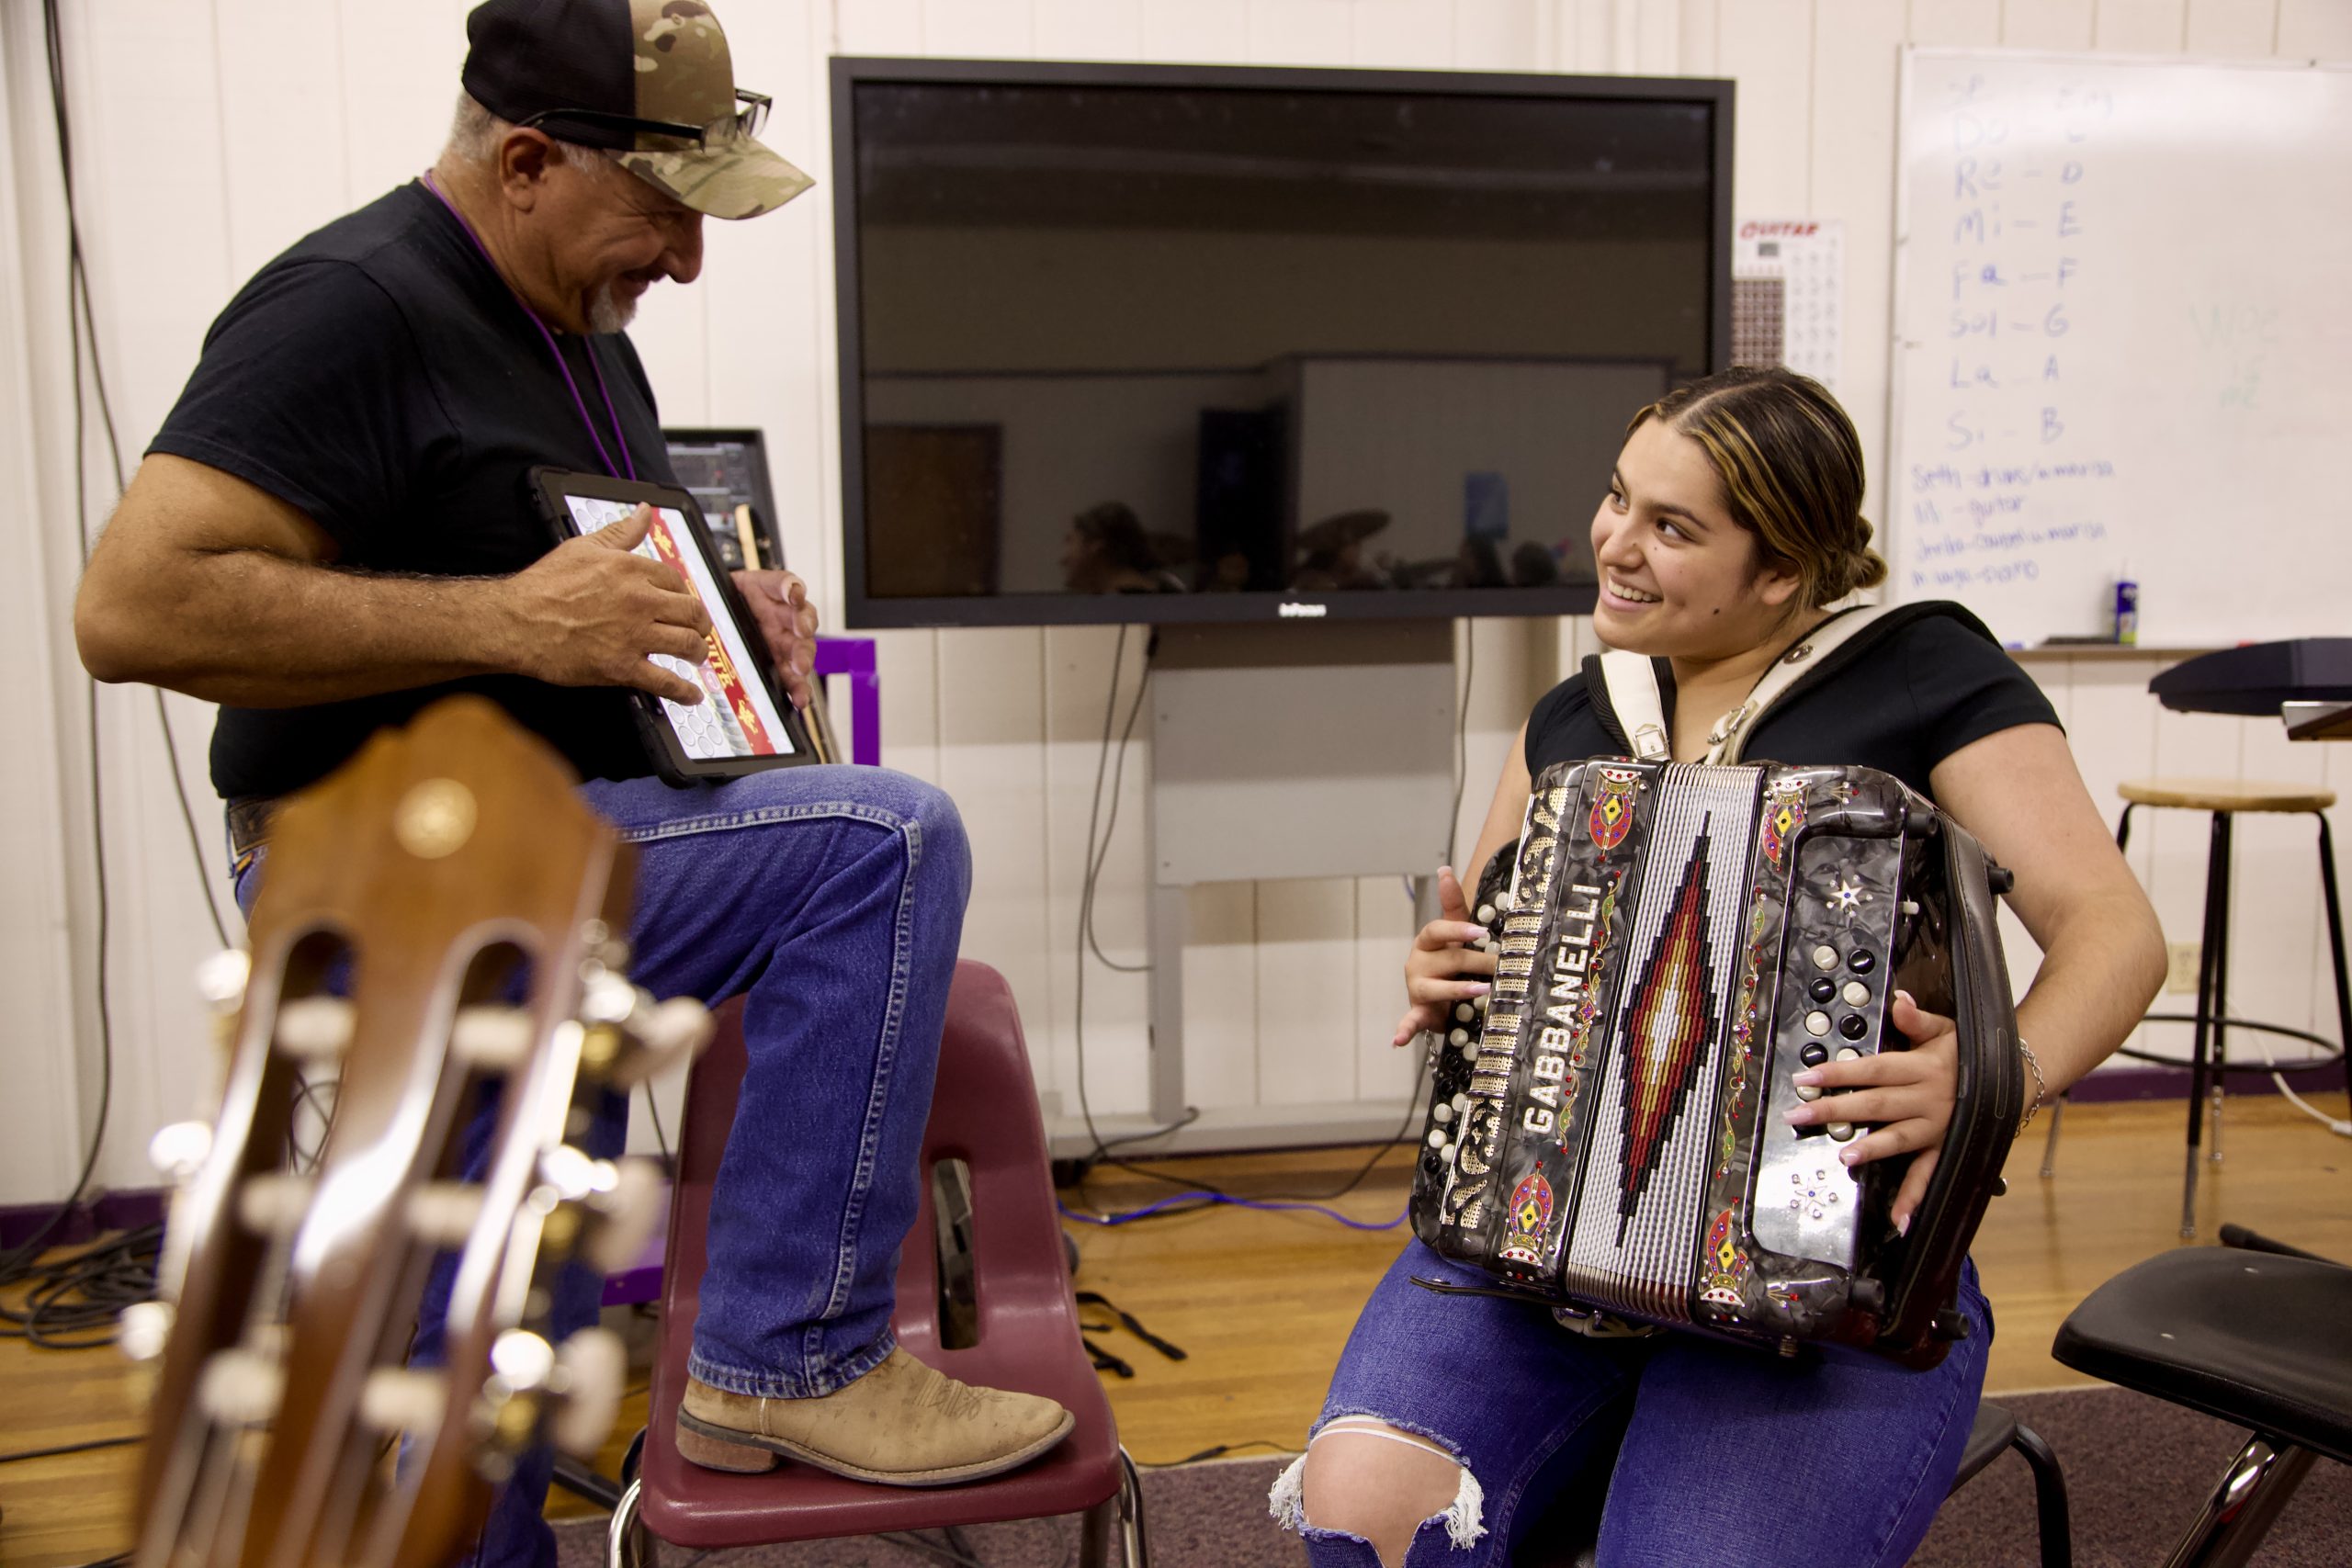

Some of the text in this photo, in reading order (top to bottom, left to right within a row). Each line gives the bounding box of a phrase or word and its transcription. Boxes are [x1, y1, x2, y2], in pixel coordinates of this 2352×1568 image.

[1954, 156, 2003, 200] Re
[2061, 159, 2085, 185] D
[1953, 198, 2002, 245] Mi
[2057, 199, 2084, 238] E
[2057, 256, 2080, 289] F
[1949, 356, 2000, 389] La
[2042, 353, 2061, 382] A
[2040, 405, 2066, 446] B
[1522, 884, 1601, 1134] GABBANELLI
